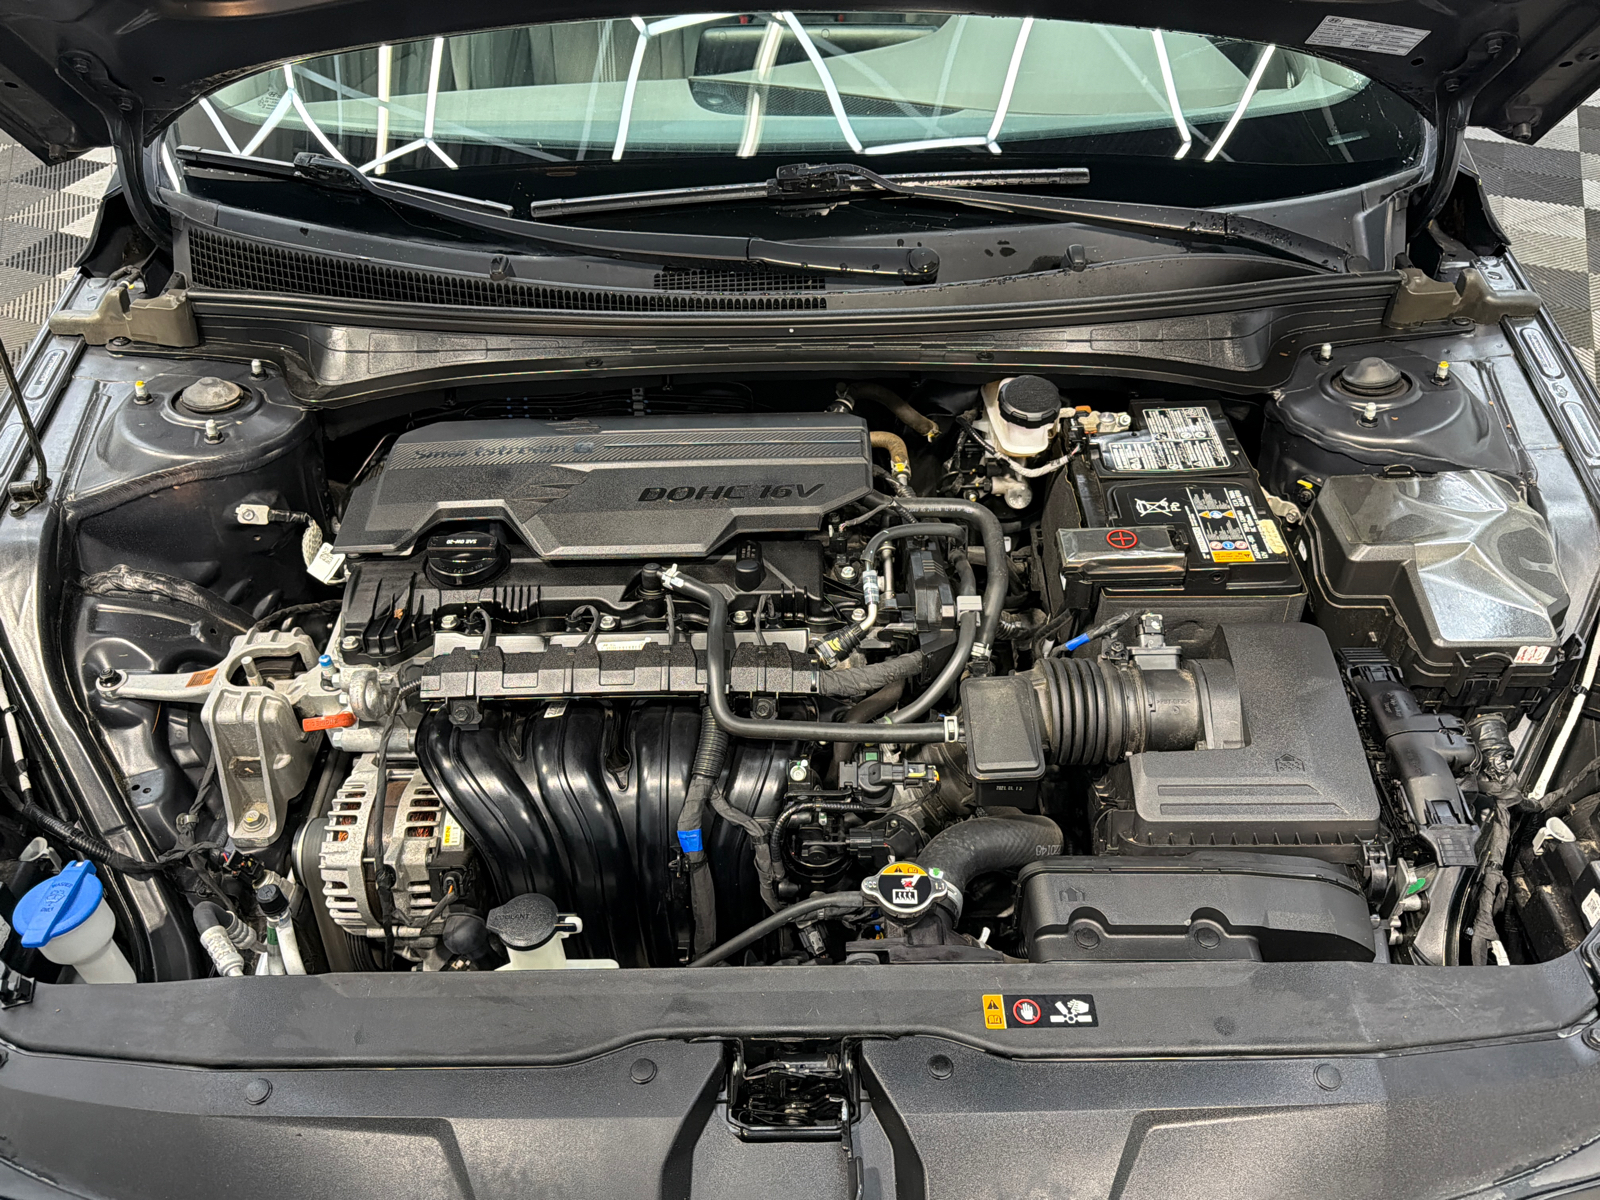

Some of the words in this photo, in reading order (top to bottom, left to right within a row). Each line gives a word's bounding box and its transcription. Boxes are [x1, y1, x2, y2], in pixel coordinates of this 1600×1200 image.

[638, 485, 748, 502] DOHC
[759, 483, 825, 499] 16V
[1170, 501, 1182, 512] Pb
[934, 881, 945, 890] 1.1
